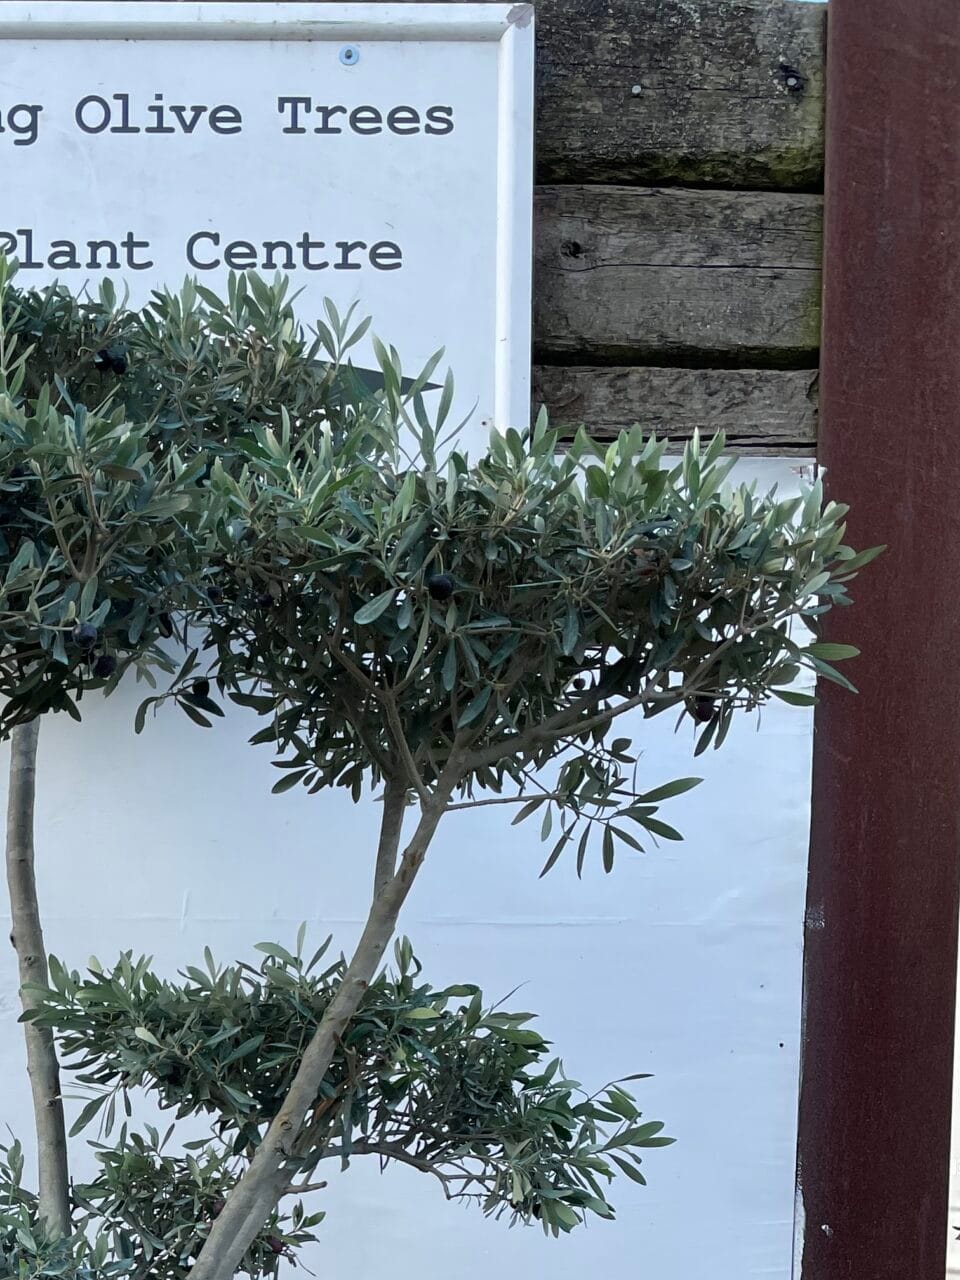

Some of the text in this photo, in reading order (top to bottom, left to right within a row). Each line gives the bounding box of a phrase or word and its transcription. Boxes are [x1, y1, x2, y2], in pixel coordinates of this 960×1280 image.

[75, 93, 243, 135] Olive
[277, 96, 455, 136] Trees
[185, 231, 403, 271] Centre
